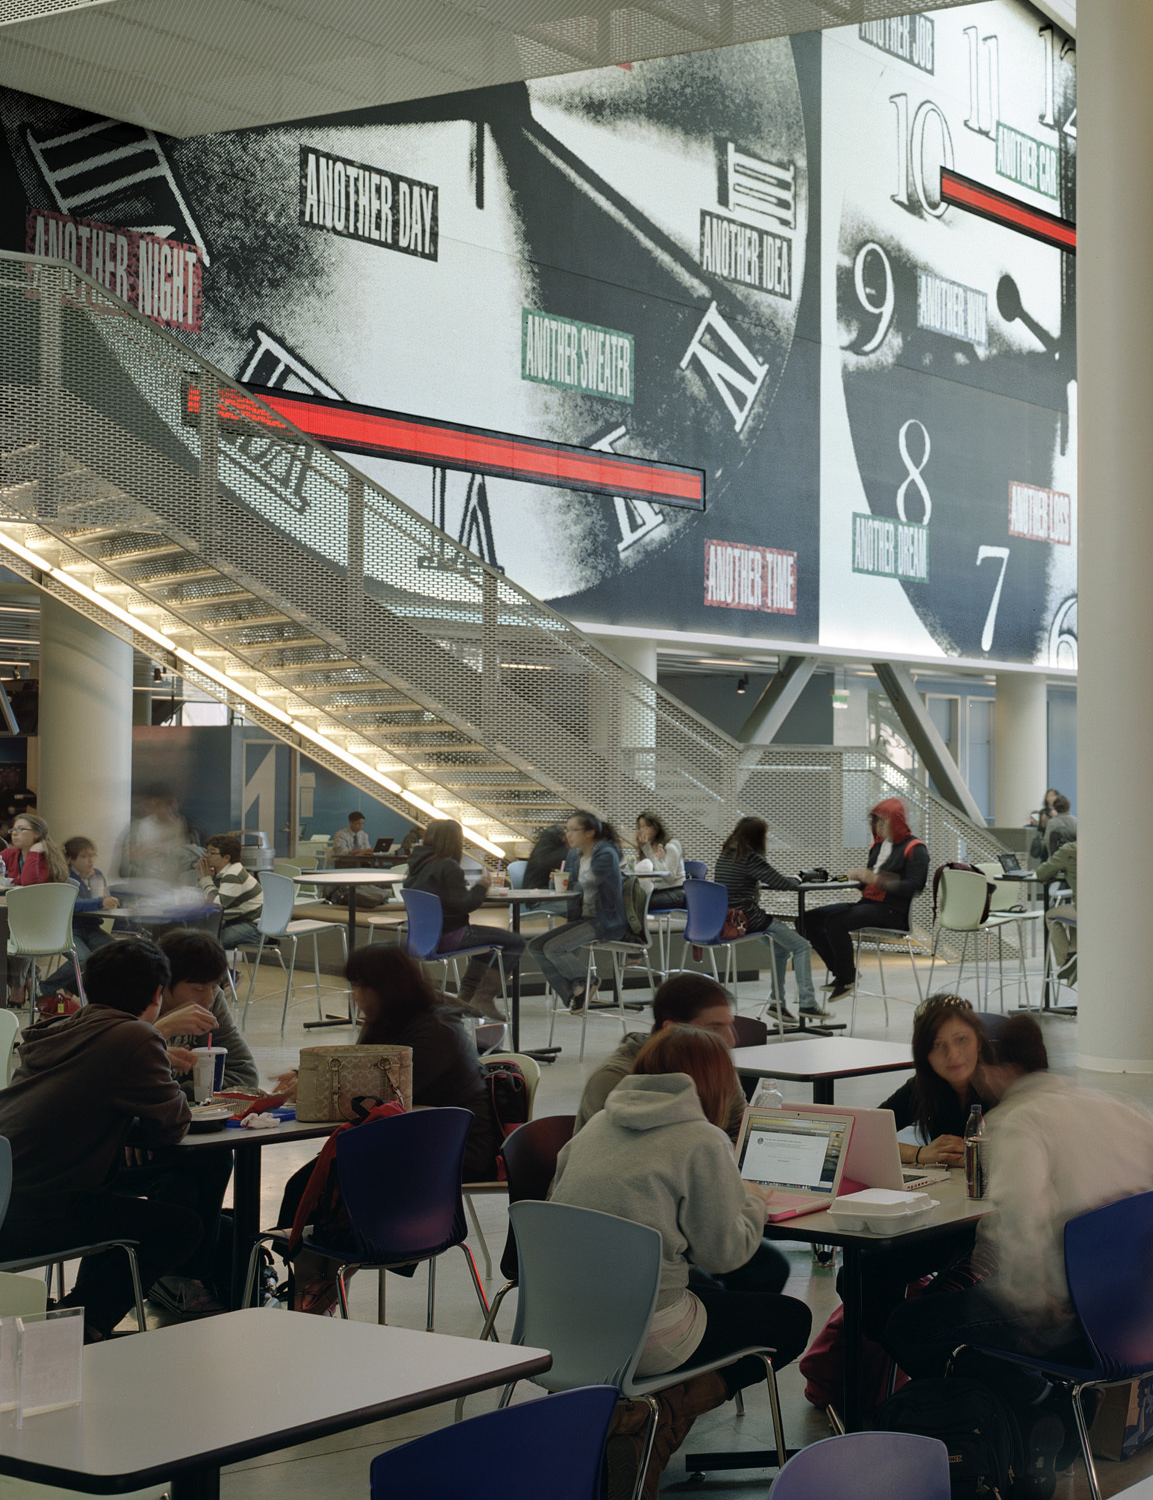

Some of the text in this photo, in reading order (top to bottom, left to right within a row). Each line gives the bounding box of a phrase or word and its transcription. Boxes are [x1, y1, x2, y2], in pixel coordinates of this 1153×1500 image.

[913, 15, 932, 70] JOB
[889, 92, 955, 219] 10
[998, 125, 1057, 197] ANOTHER CAR
[305, 153, 433, 254] ANOTHER DAY
[34, 215, 198, 325] ANOTHER NIGHT
[703, 215, 789, 295] ANOTHER IDEA
[840, 241, 895, 355] 9
[920, 275, 965, 336] ANOTHER
[526, 314, 630, 398] ANOTHER SWEATER
[897, 419, 932, 526] 8
[1010, 484, 1048, 538] ANOTHER
[707, 544, 794, 609] ANOTHER TIME
[854, 517, 927, 579] ANOTHER DREAM
[976, 545, 1010, 652] 7
